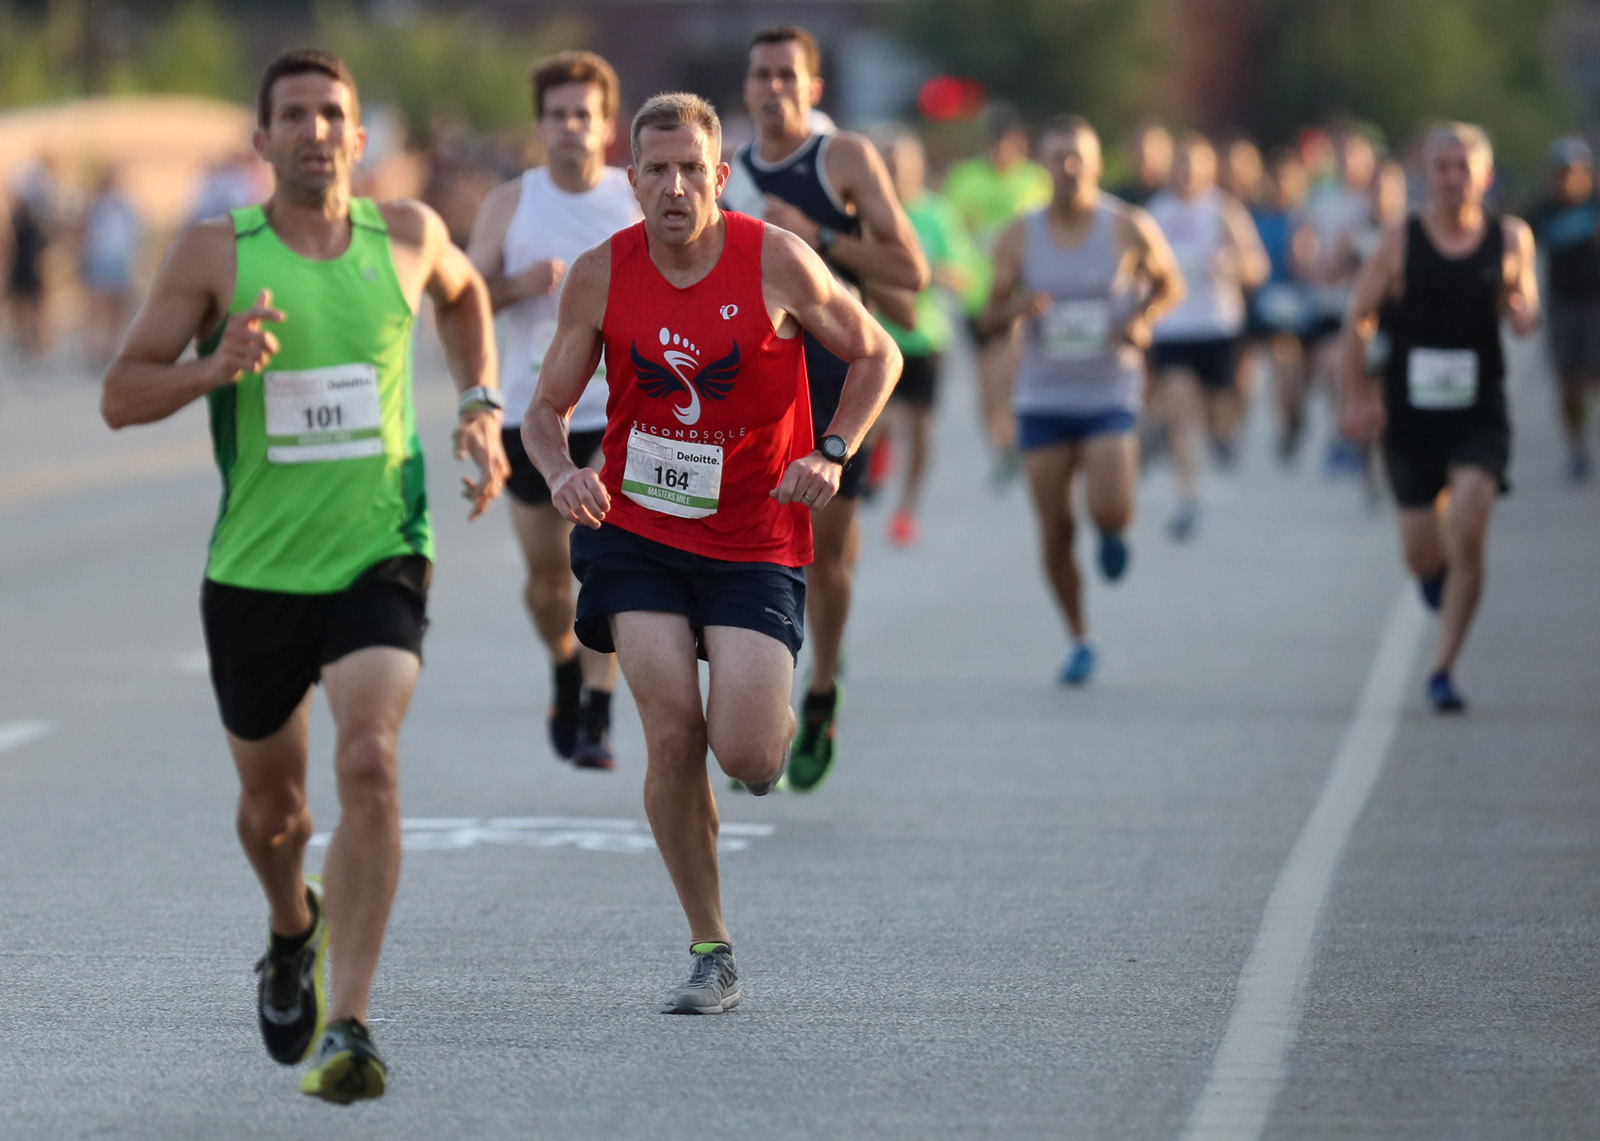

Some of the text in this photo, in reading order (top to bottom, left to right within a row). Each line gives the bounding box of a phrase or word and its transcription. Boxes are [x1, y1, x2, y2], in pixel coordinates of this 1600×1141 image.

[303, 404, 342, 428] 101
[677, 451, 720, 465] Deloitte.
[654, 465, 689, 490] 164
[647, 486, 690, 505] MASTERS MILE
